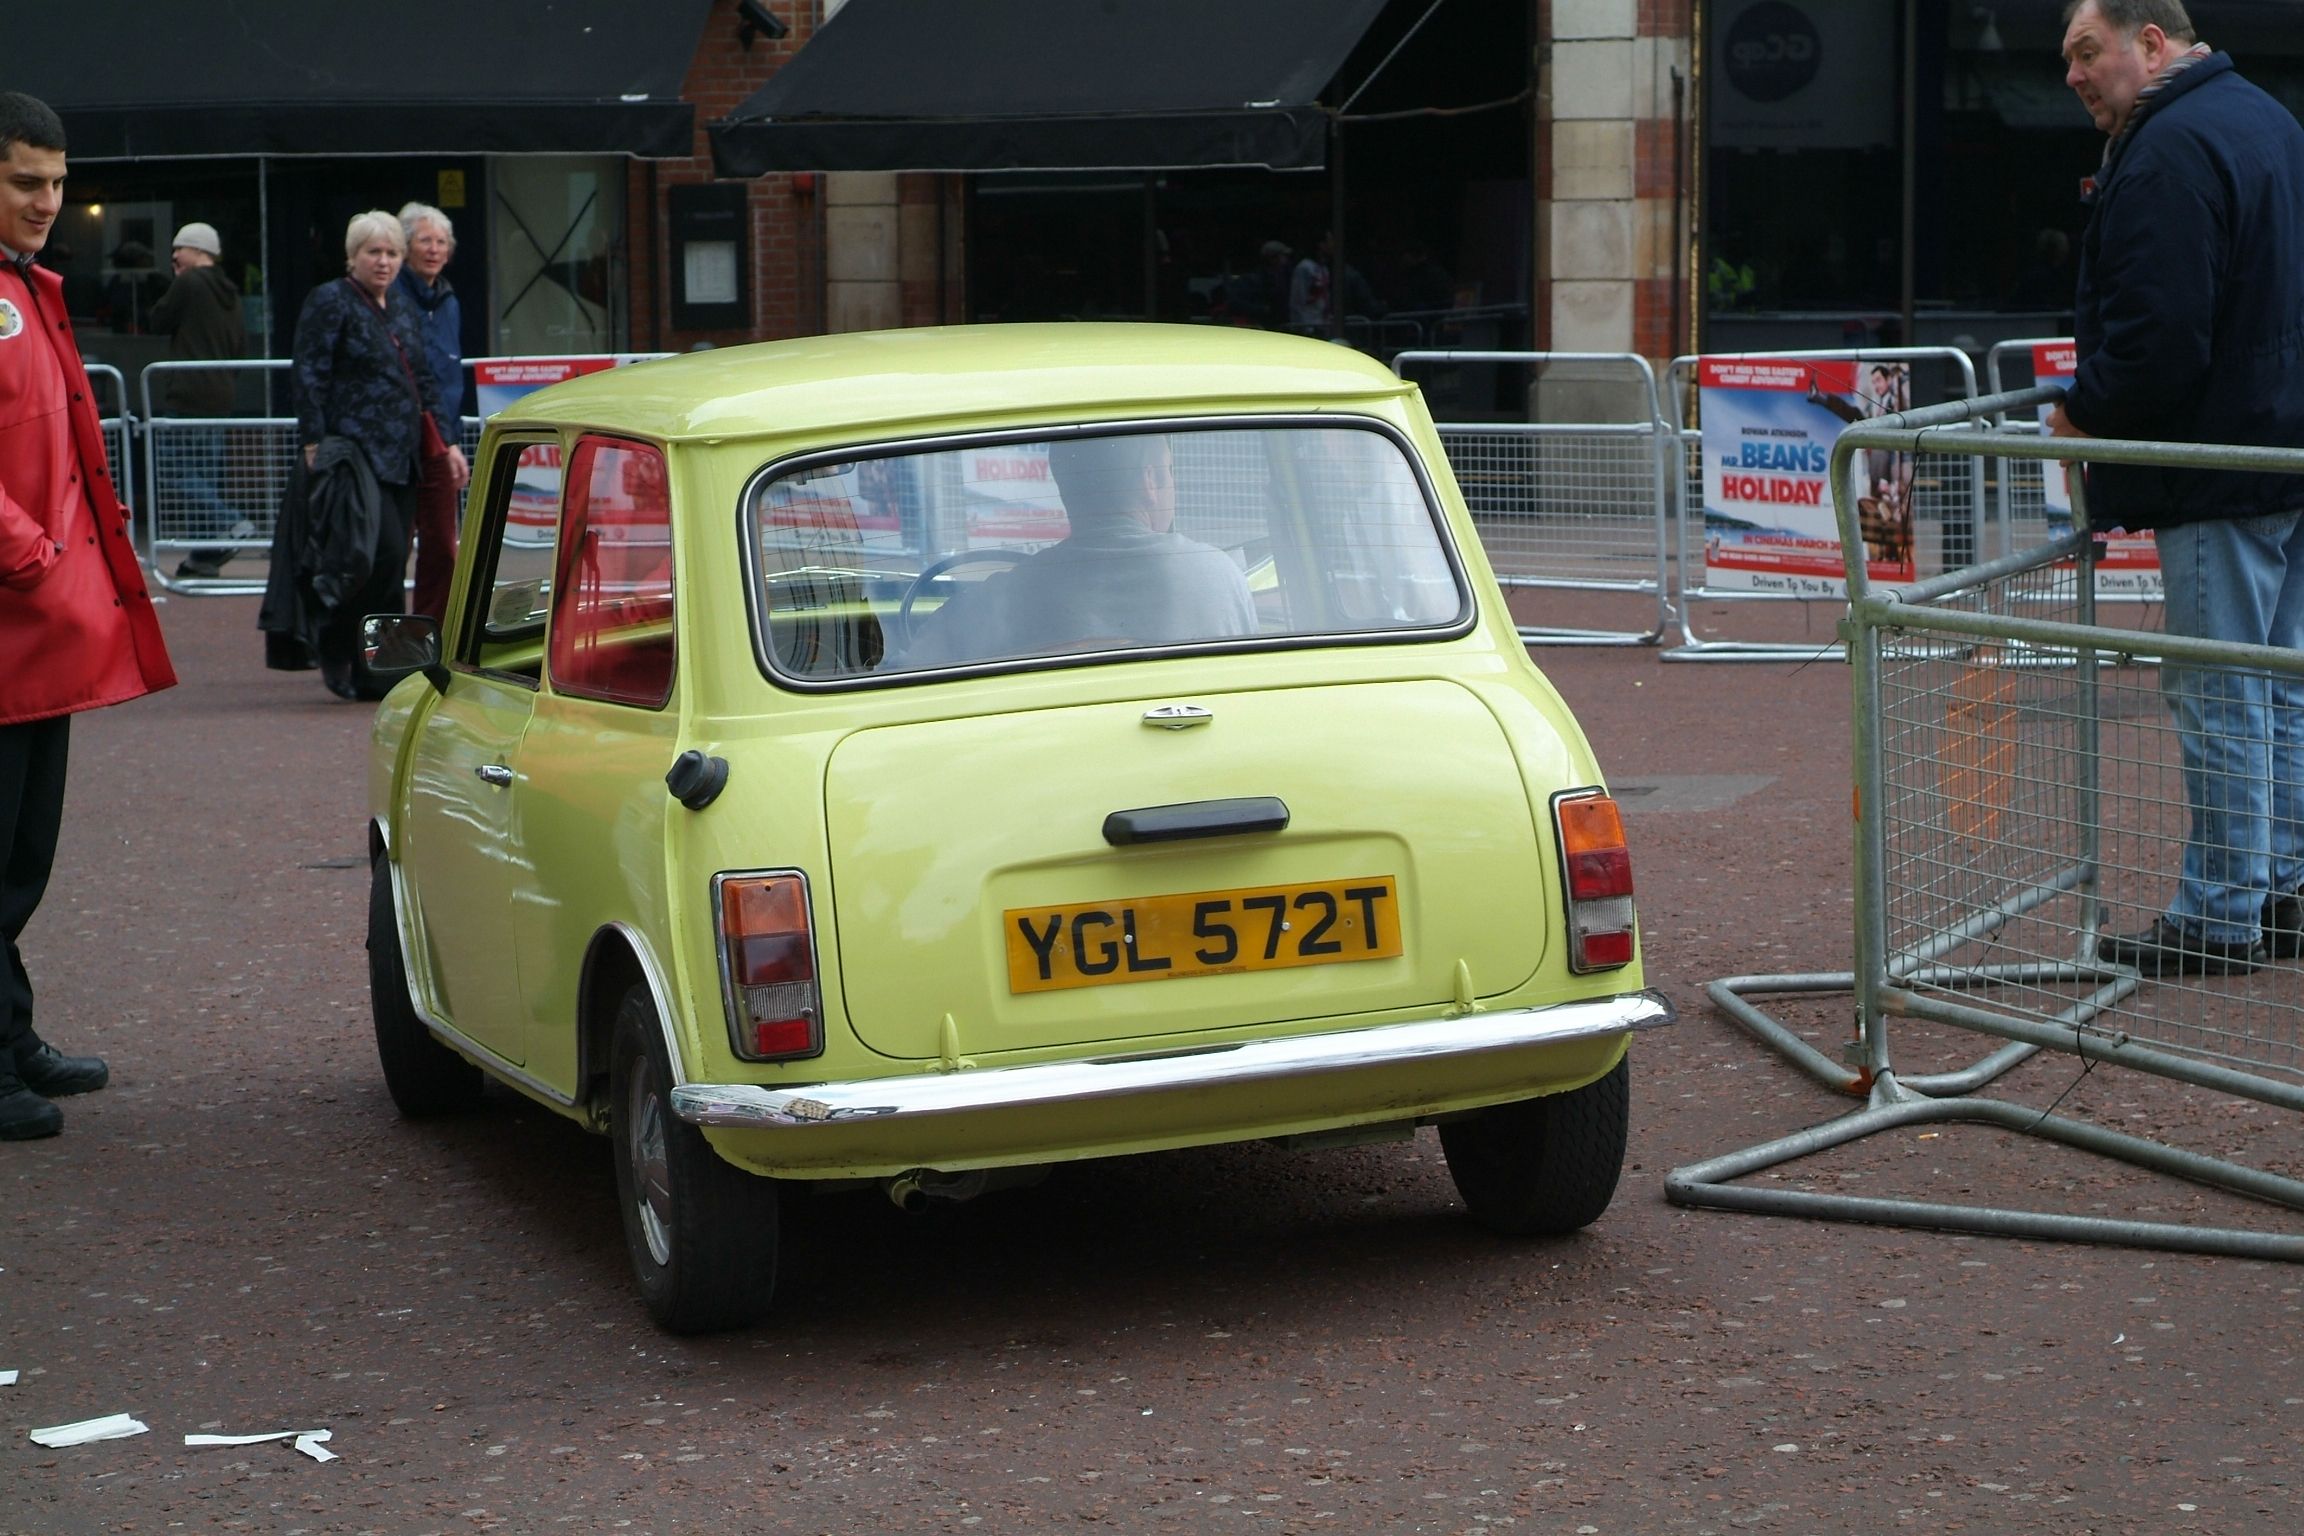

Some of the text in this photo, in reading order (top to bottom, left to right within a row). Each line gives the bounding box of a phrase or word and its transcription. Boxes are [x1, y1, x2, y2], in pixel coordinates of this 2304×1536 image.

[1770, 429, 1808, 438] ATKINSON
[1741, 441, 1826, 473] BEAN'S
[976, 458, 1048, 481] HOLIDAY
[1722, 474, 1824, 506] HOLIDAY
[1743, 533, 1753, 544] IN
[1754, 536, 1794, 547] CINEMAS
[1796, 540, 1828, 550] MARCH
[1752, 575, 1835, 595] Driven To You By
[2100, 575, 2134, 588] Driven
[2136, 575, 2148, 588] To
[1018, 885, 1388, 981] YGL 572T
